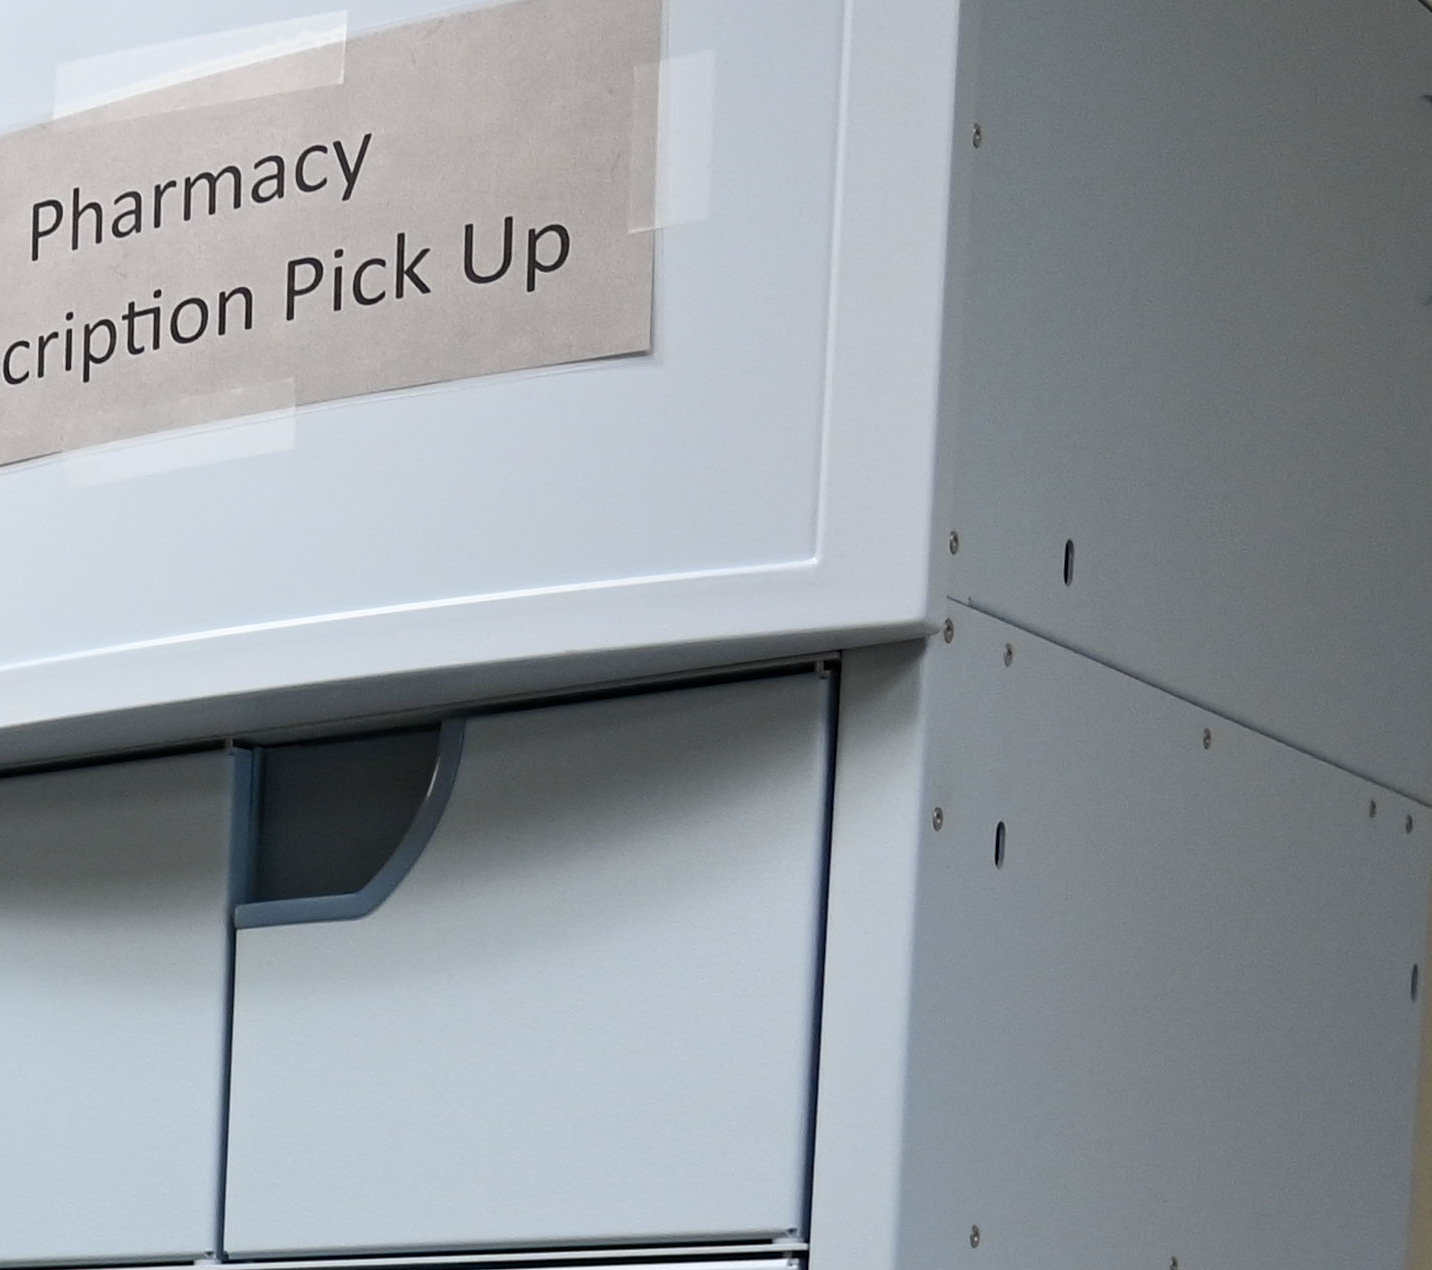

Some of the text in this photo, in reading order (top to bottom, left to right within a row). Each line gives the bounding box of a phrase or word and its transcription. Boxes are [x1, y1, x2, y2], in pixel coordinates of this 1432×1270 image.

[30, 131, 374, 263] Pharmacy
[285, 231, 432, 322] Pick
[462, 215, 572, 294] Up
